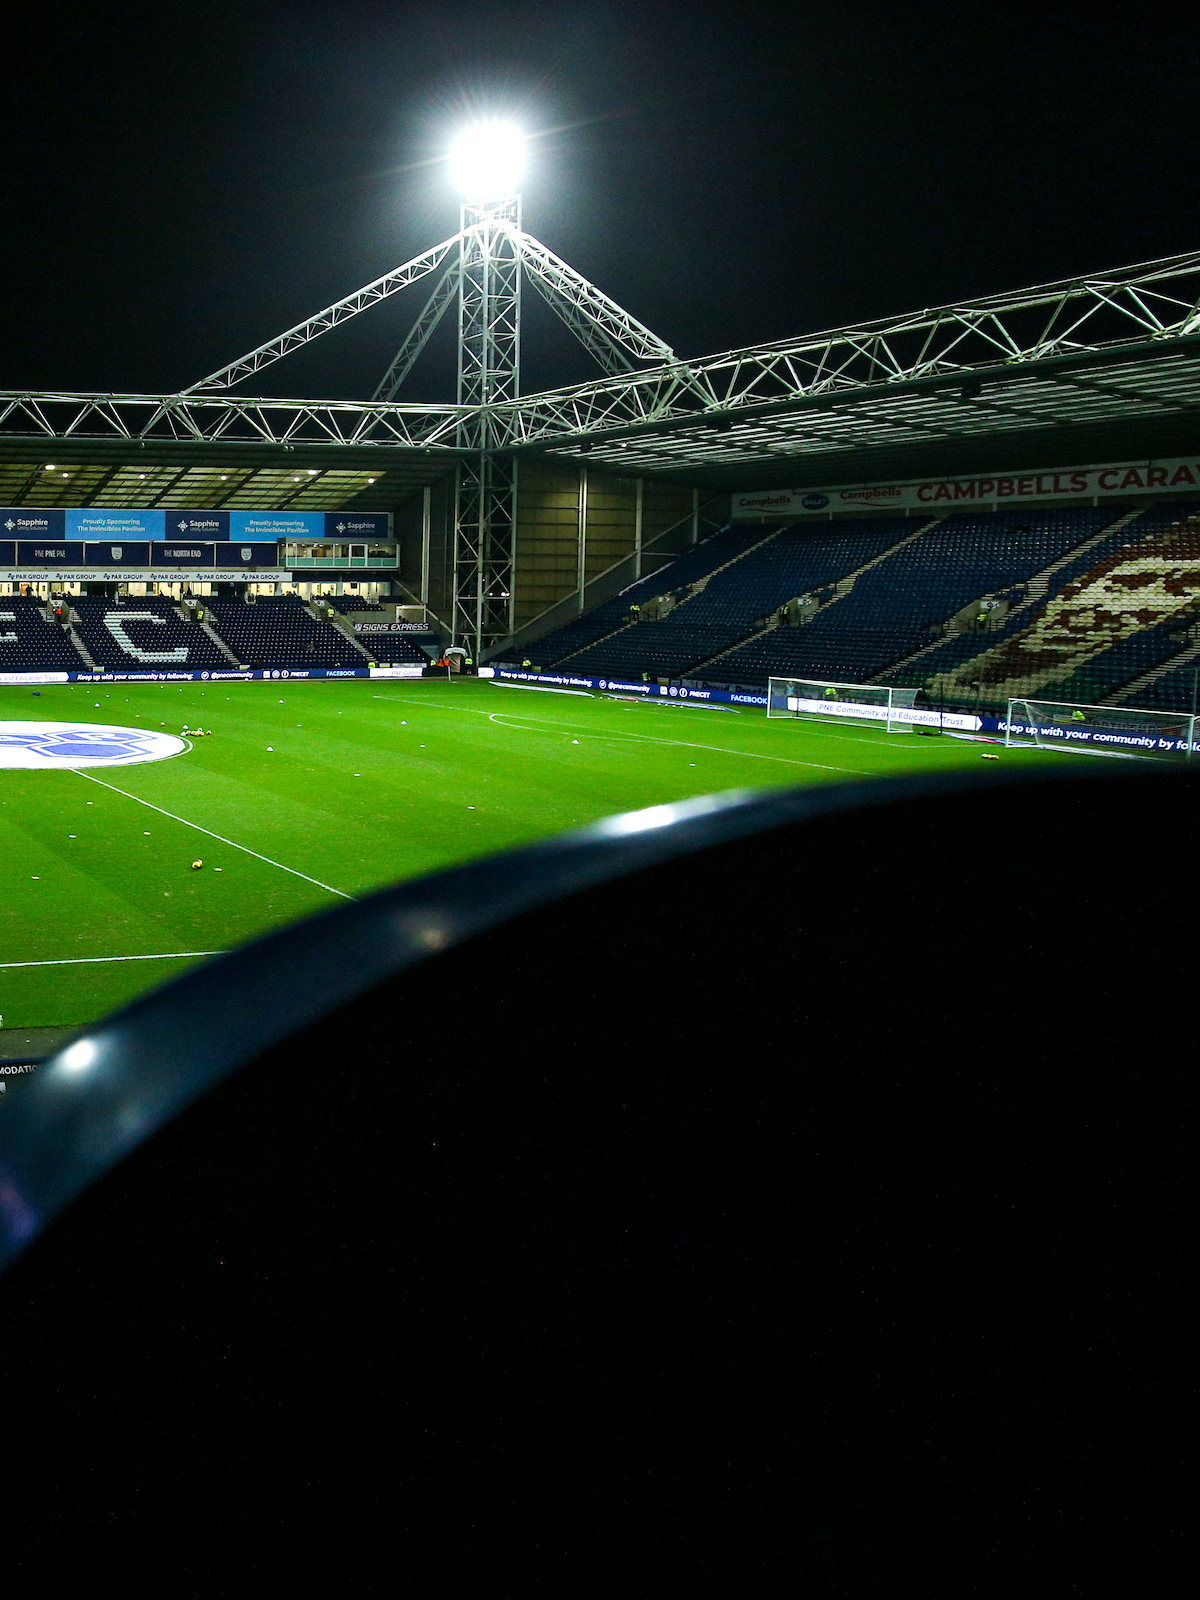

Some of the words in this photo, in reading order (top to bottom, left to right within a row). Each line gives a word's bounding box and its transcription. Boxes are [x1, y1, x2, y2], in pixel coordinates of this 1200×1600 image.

[917, 472, 1088, 502] CAMPBELLS
[1098, 464, 1200, 491] CARA
[840, 487, 902, 500] Campbells
[739, 495, 791, 507] Campbells
[17, 518, 48, 527] Sapphire
[190, 520, 220, 528] Sapphire
[347, 522, 376, 530] Sapphire
[104, 611, 188, 662] C
[538, 675, 563, 684] community
[608, 682, 650, 693] @pnecommunity
[731, 694, 768, 704] FACEBOOK
[819, 704, 834, 712] PNE
[836, 705, 879, 718] Community
[881, 710, 896, 718] ad
[898, 711, 939, 723] Education
[942, 716, 964, 726] Trust
[1025, 727, 1038, 735] up
[1041, 728, 1064, 737] with
[1065, 731, 1091, 740] your
[1093, 732, 1156, 748] community
[1159, 738, 1174, 750] by
[1176, 740, 1200, 751] folo
